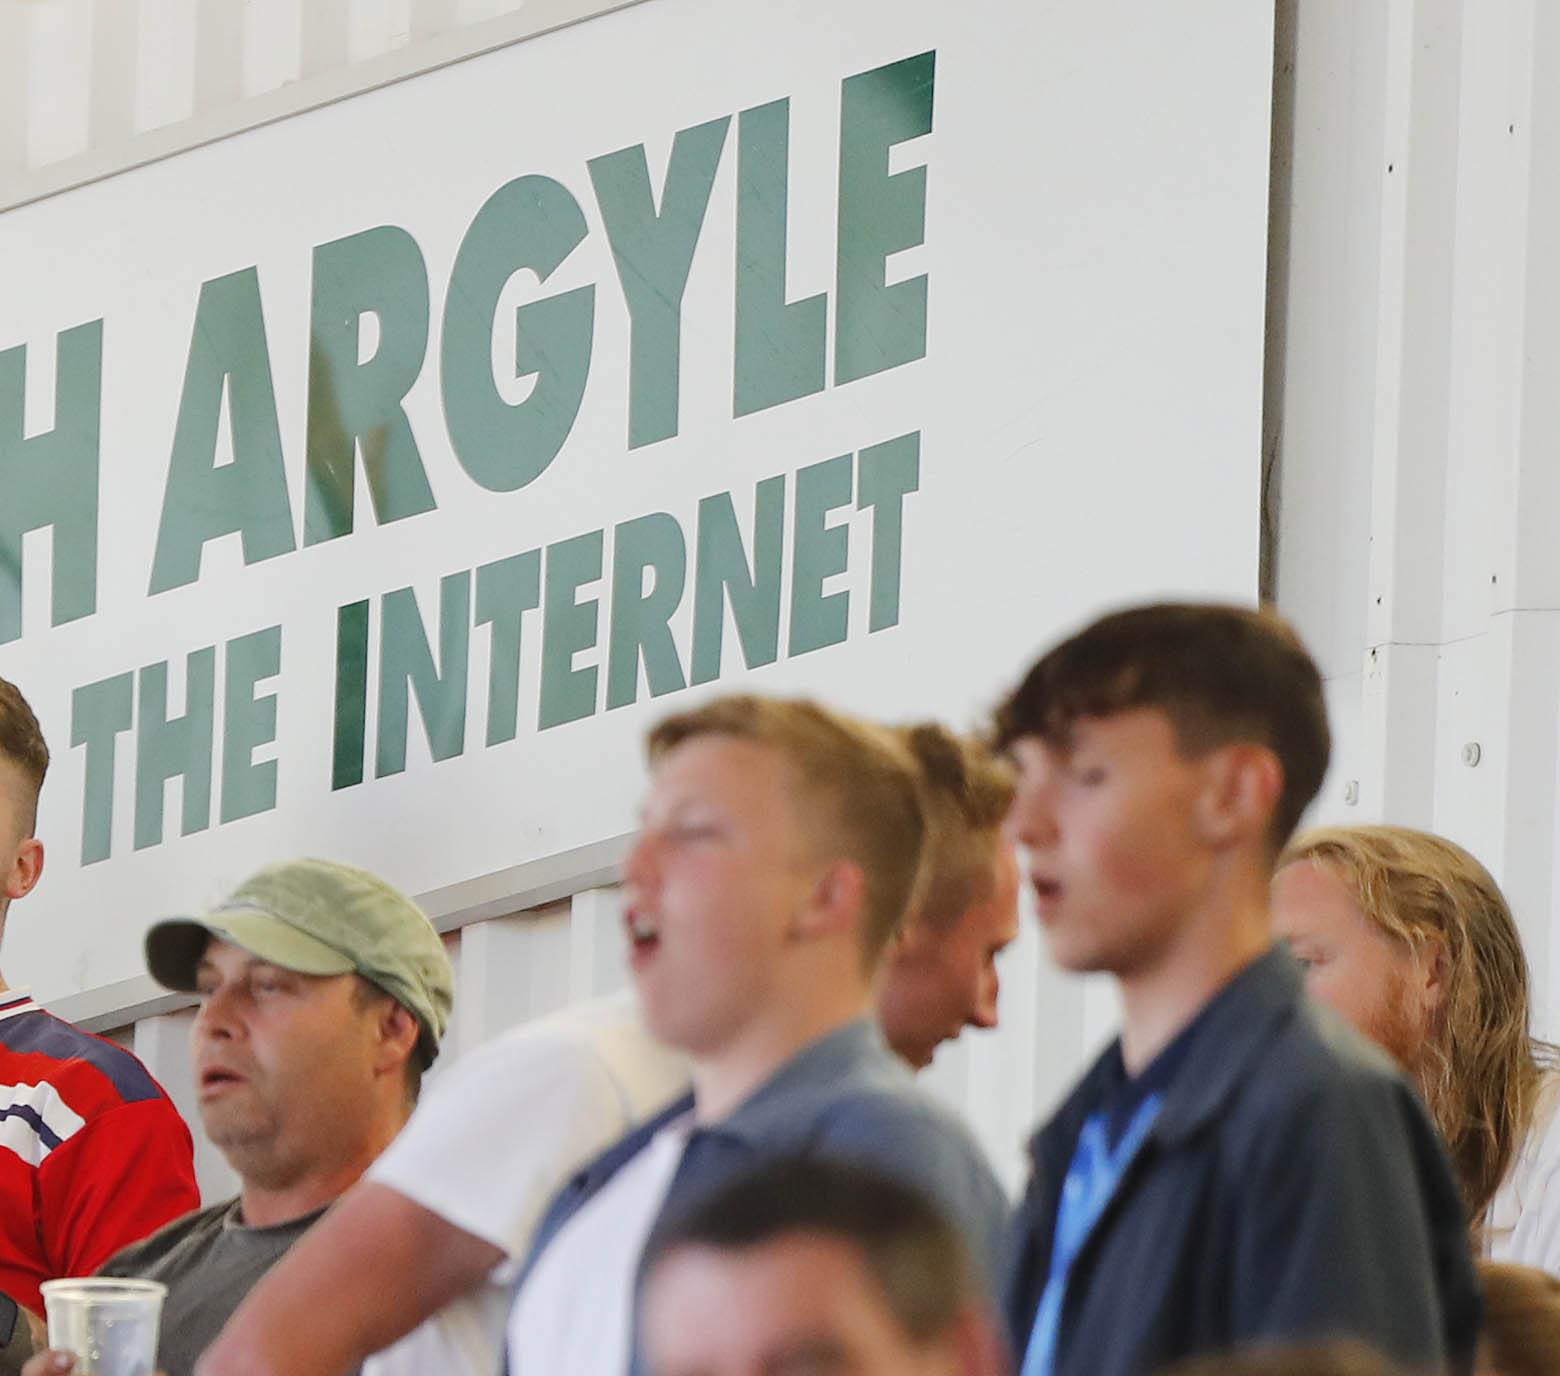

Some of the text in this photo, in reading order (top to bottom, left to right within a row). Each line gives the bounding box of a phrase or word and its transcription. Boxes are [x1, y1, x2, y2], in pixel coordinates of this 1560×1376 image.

[147, 48, 938, 594] ARGYLE
[70, 430, 922, 866] THE INTERNET
